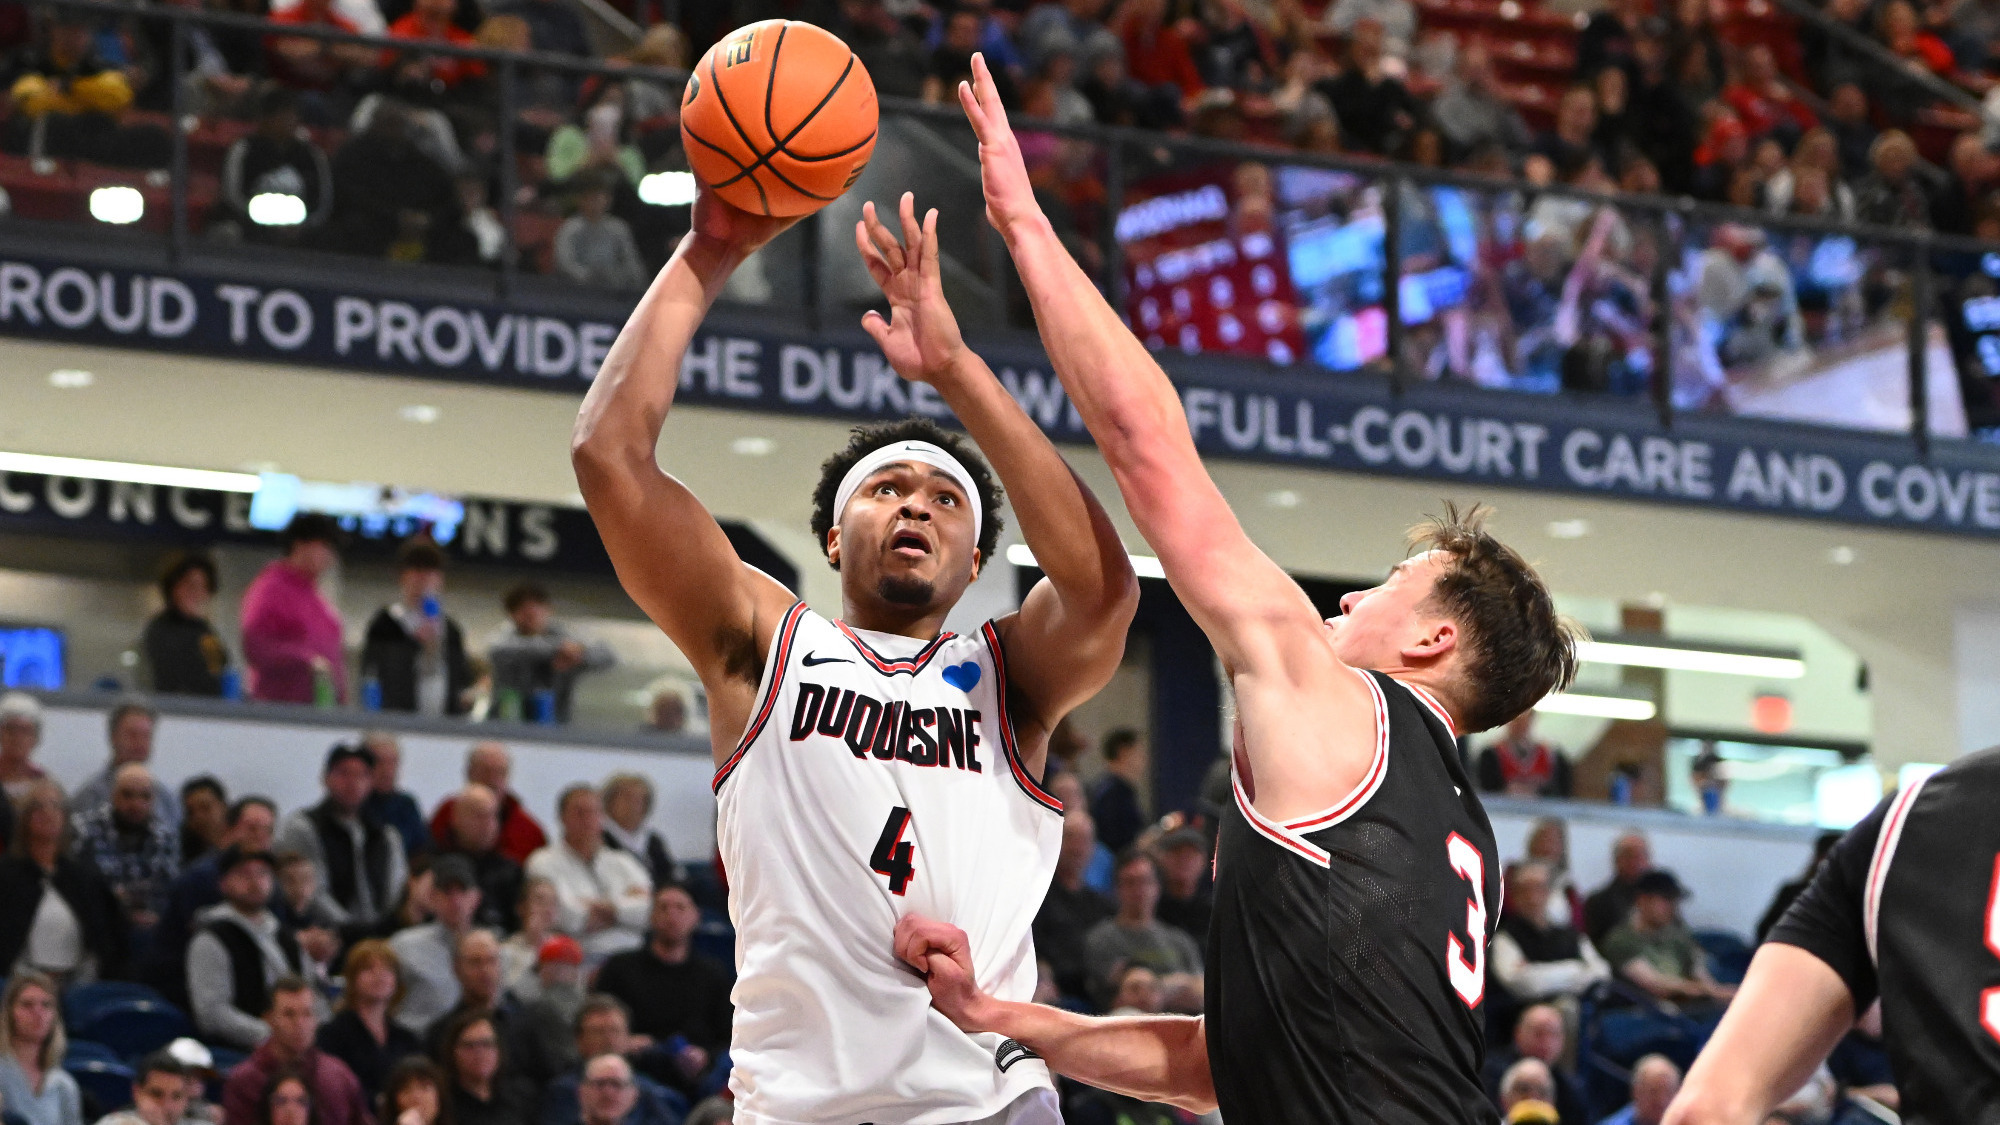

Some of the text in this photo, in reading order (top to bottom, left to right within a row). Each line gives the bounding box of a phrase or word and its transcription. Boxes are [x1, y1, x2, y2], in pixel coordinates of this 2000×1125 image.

[0, 263, 196, 338] ROUD
[216, 283, 314, 350] TO
[333, 296, 621, 381] PROVIDE
[679, 336, 763, 397] HE
[1184, 387, 1548, 478] FULL-COURT
[1561, 428, 1715, 498] CARE
[1727, 447, 1848, 512] AND
[789, 682, 982, 774] DUQUESNE
[869, 806, 916, 896] 4
[1445, 830, 1487, 1010] 3
